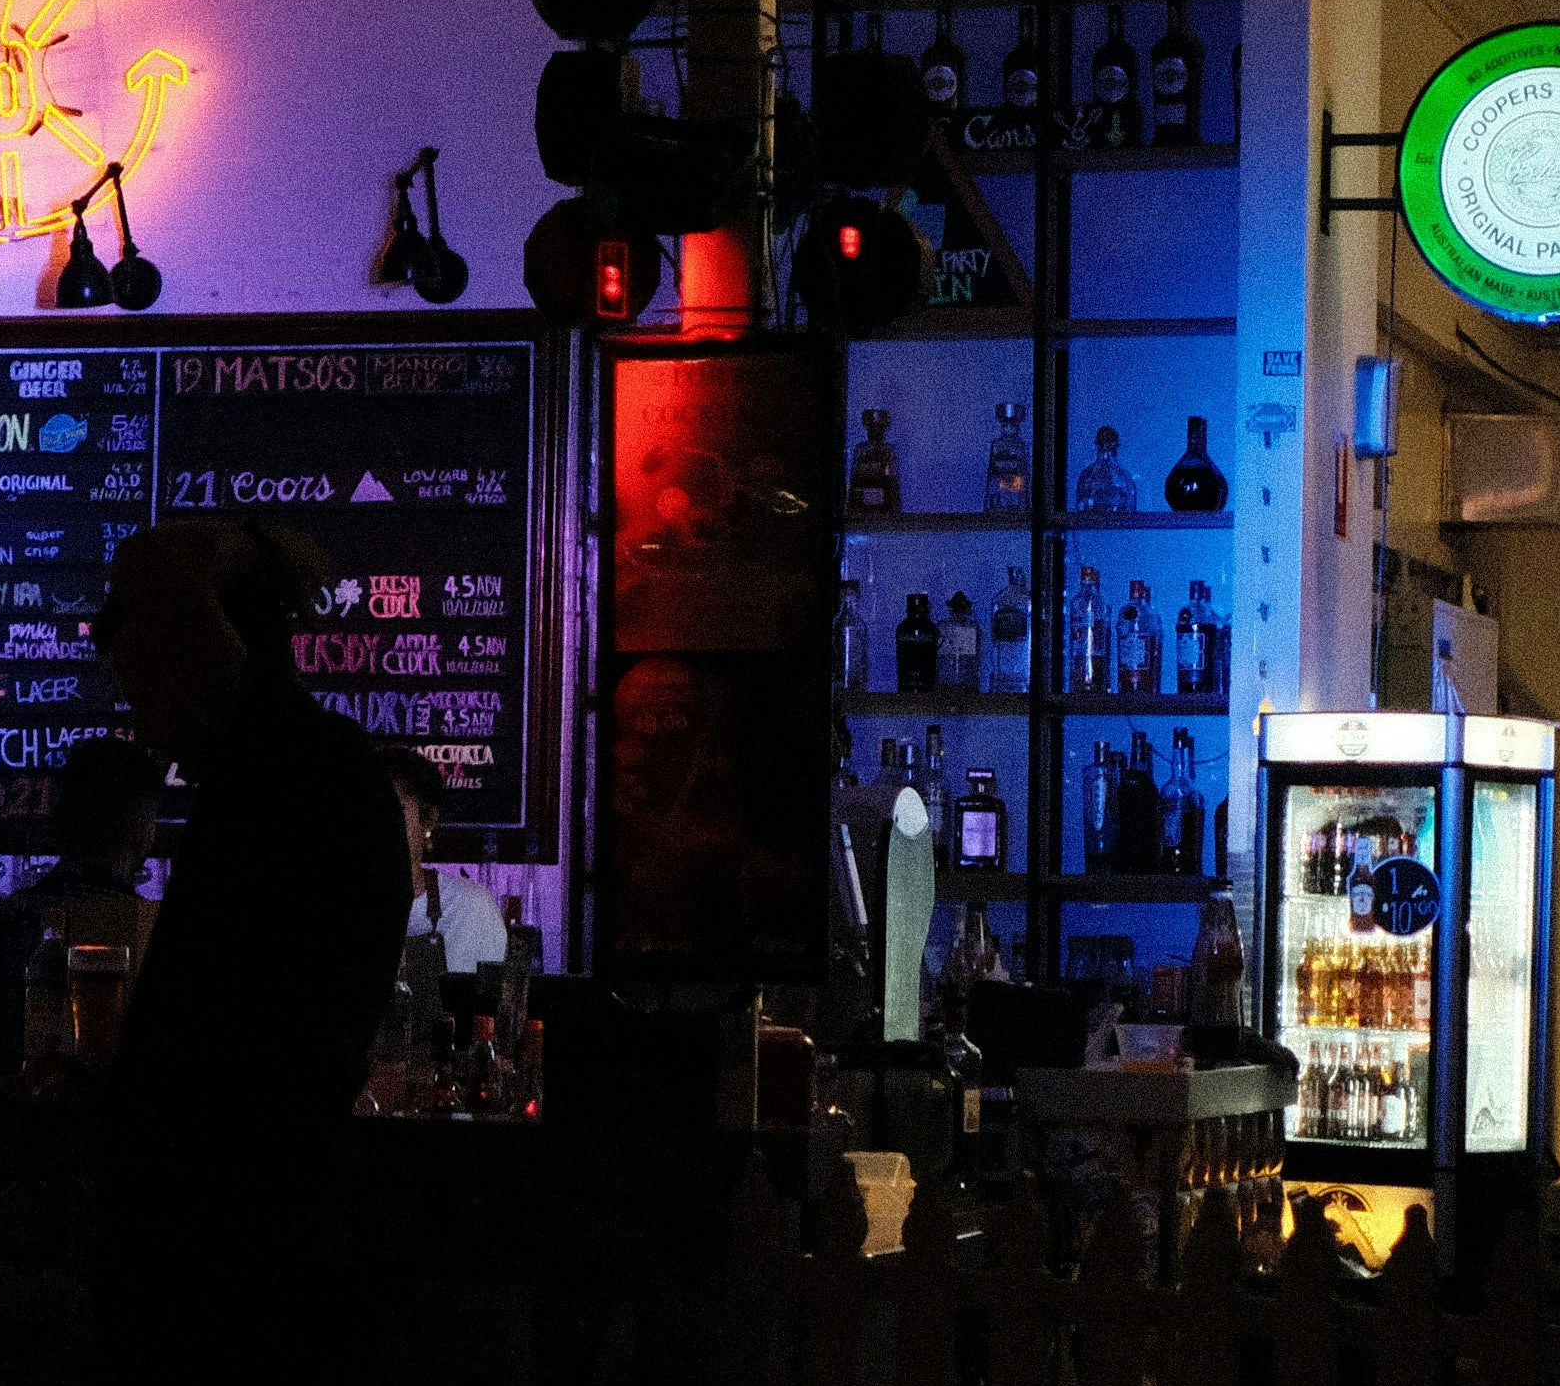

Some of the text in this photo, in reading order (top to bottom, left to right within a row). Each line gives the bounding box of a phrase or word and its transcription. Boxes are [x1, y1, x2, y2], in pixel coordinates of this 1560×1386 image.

[1463, 82, 1553, 152] COOPERS
[1458, 177, 1527, 258] ORIGINAL
[941, 248, 991, 278] PARTY
[1431, 222, 1482, 284] AUSTRALIAN
[1484, 277, 1514, 297] MADE
[927, 273, 973, 305] IN
[9, 360, 83, 381] GINGER
[173, 357, 203, 394] 19
[374, 355, 462, 373] MANGO
[19, 381, 67, 399] BEER
[172, 471, 335, 508] 21 Coors
[403, 469, 468, 483] LOW CARB
[418, 484, 452, 498] BEER
[13, 583, 43, 607] IPA
[369, 575, 421, 594] IRISH
[368, 593, 421, 619] CIDER
[382, 649, 442, 676] CIDER
[15, 677, 81, 704] LAGER
[366, 691, 421, 735] DRY
